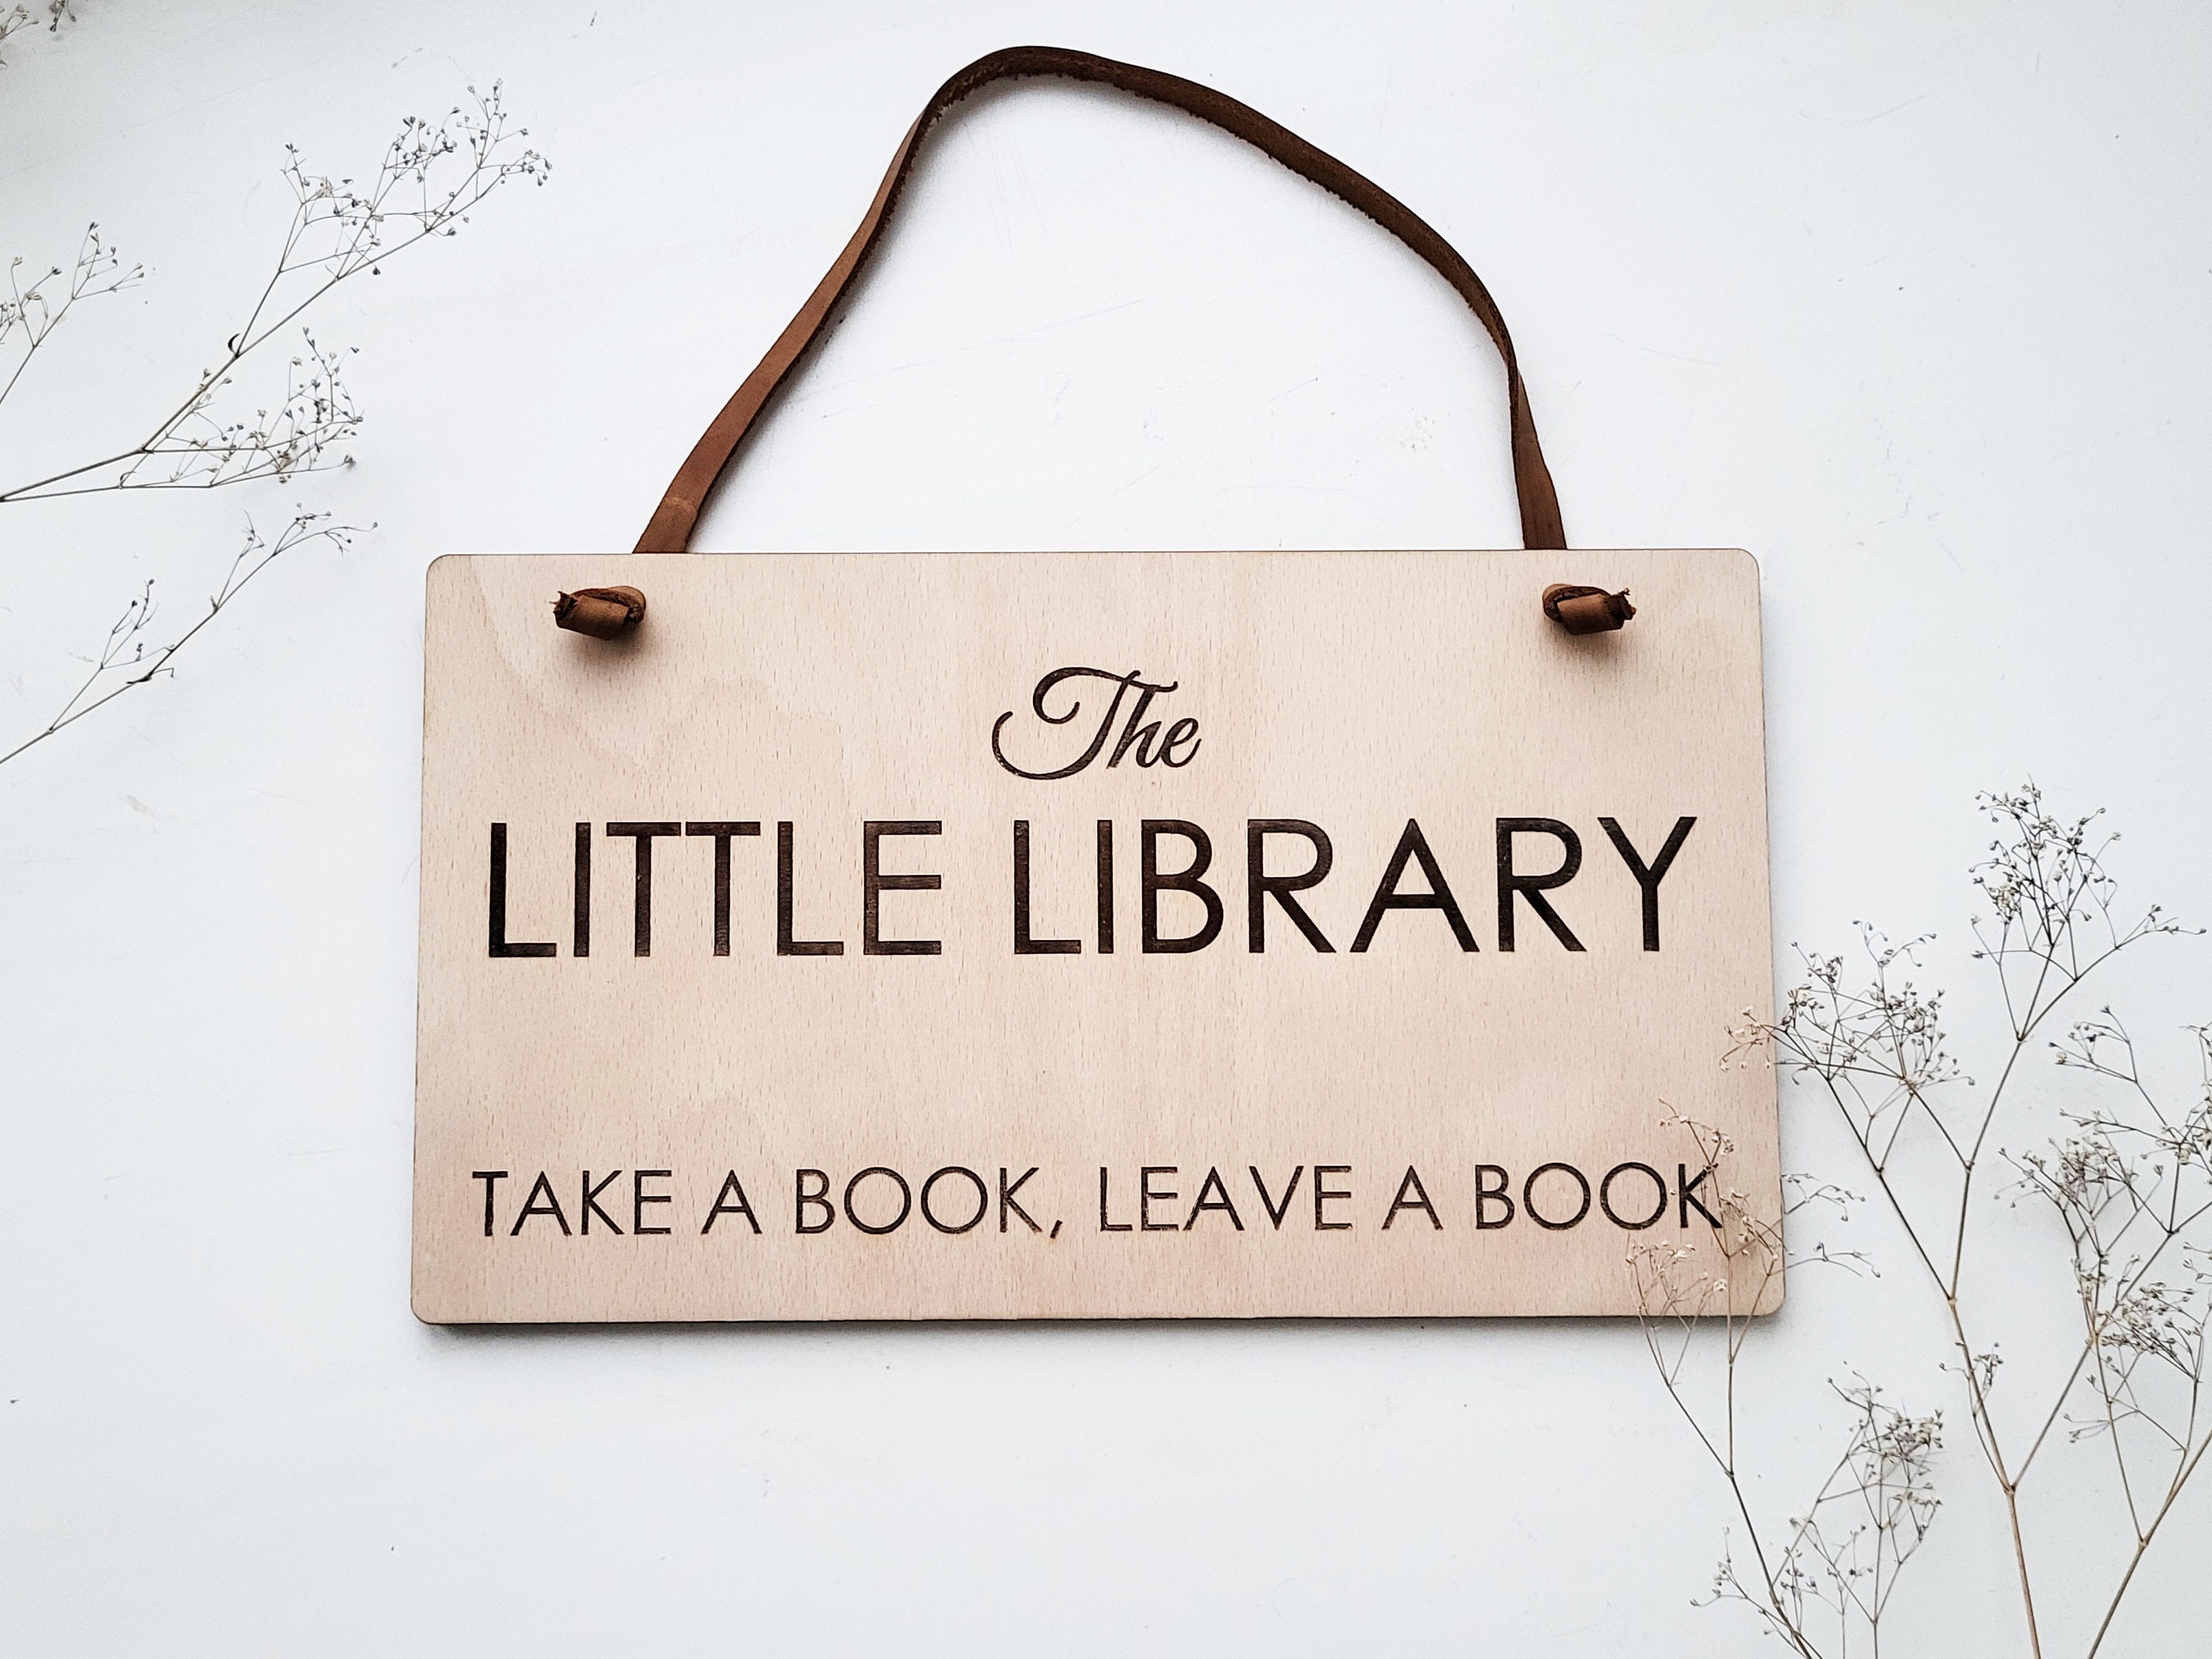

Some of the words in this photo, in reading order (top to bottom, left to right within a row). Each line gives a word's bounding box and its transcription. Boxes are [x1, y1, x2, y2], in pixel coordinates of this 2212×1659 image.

[992, 667, 1202, 781] The
[488, 821, 942, 959] LITTLE
[1013, 817, 1698, 955] LIBRARY
[472, 1169, 672, 1237] TAKE
[700, 1169, 763, 1235] A
[795, 1166, 1063, 1240] BOOK,
[1099, 1165, 1353, 1232] LEAVE
[1381, 1164, 1444, 1231] A
[1475, 1162, 1723, 1231] BOOK
